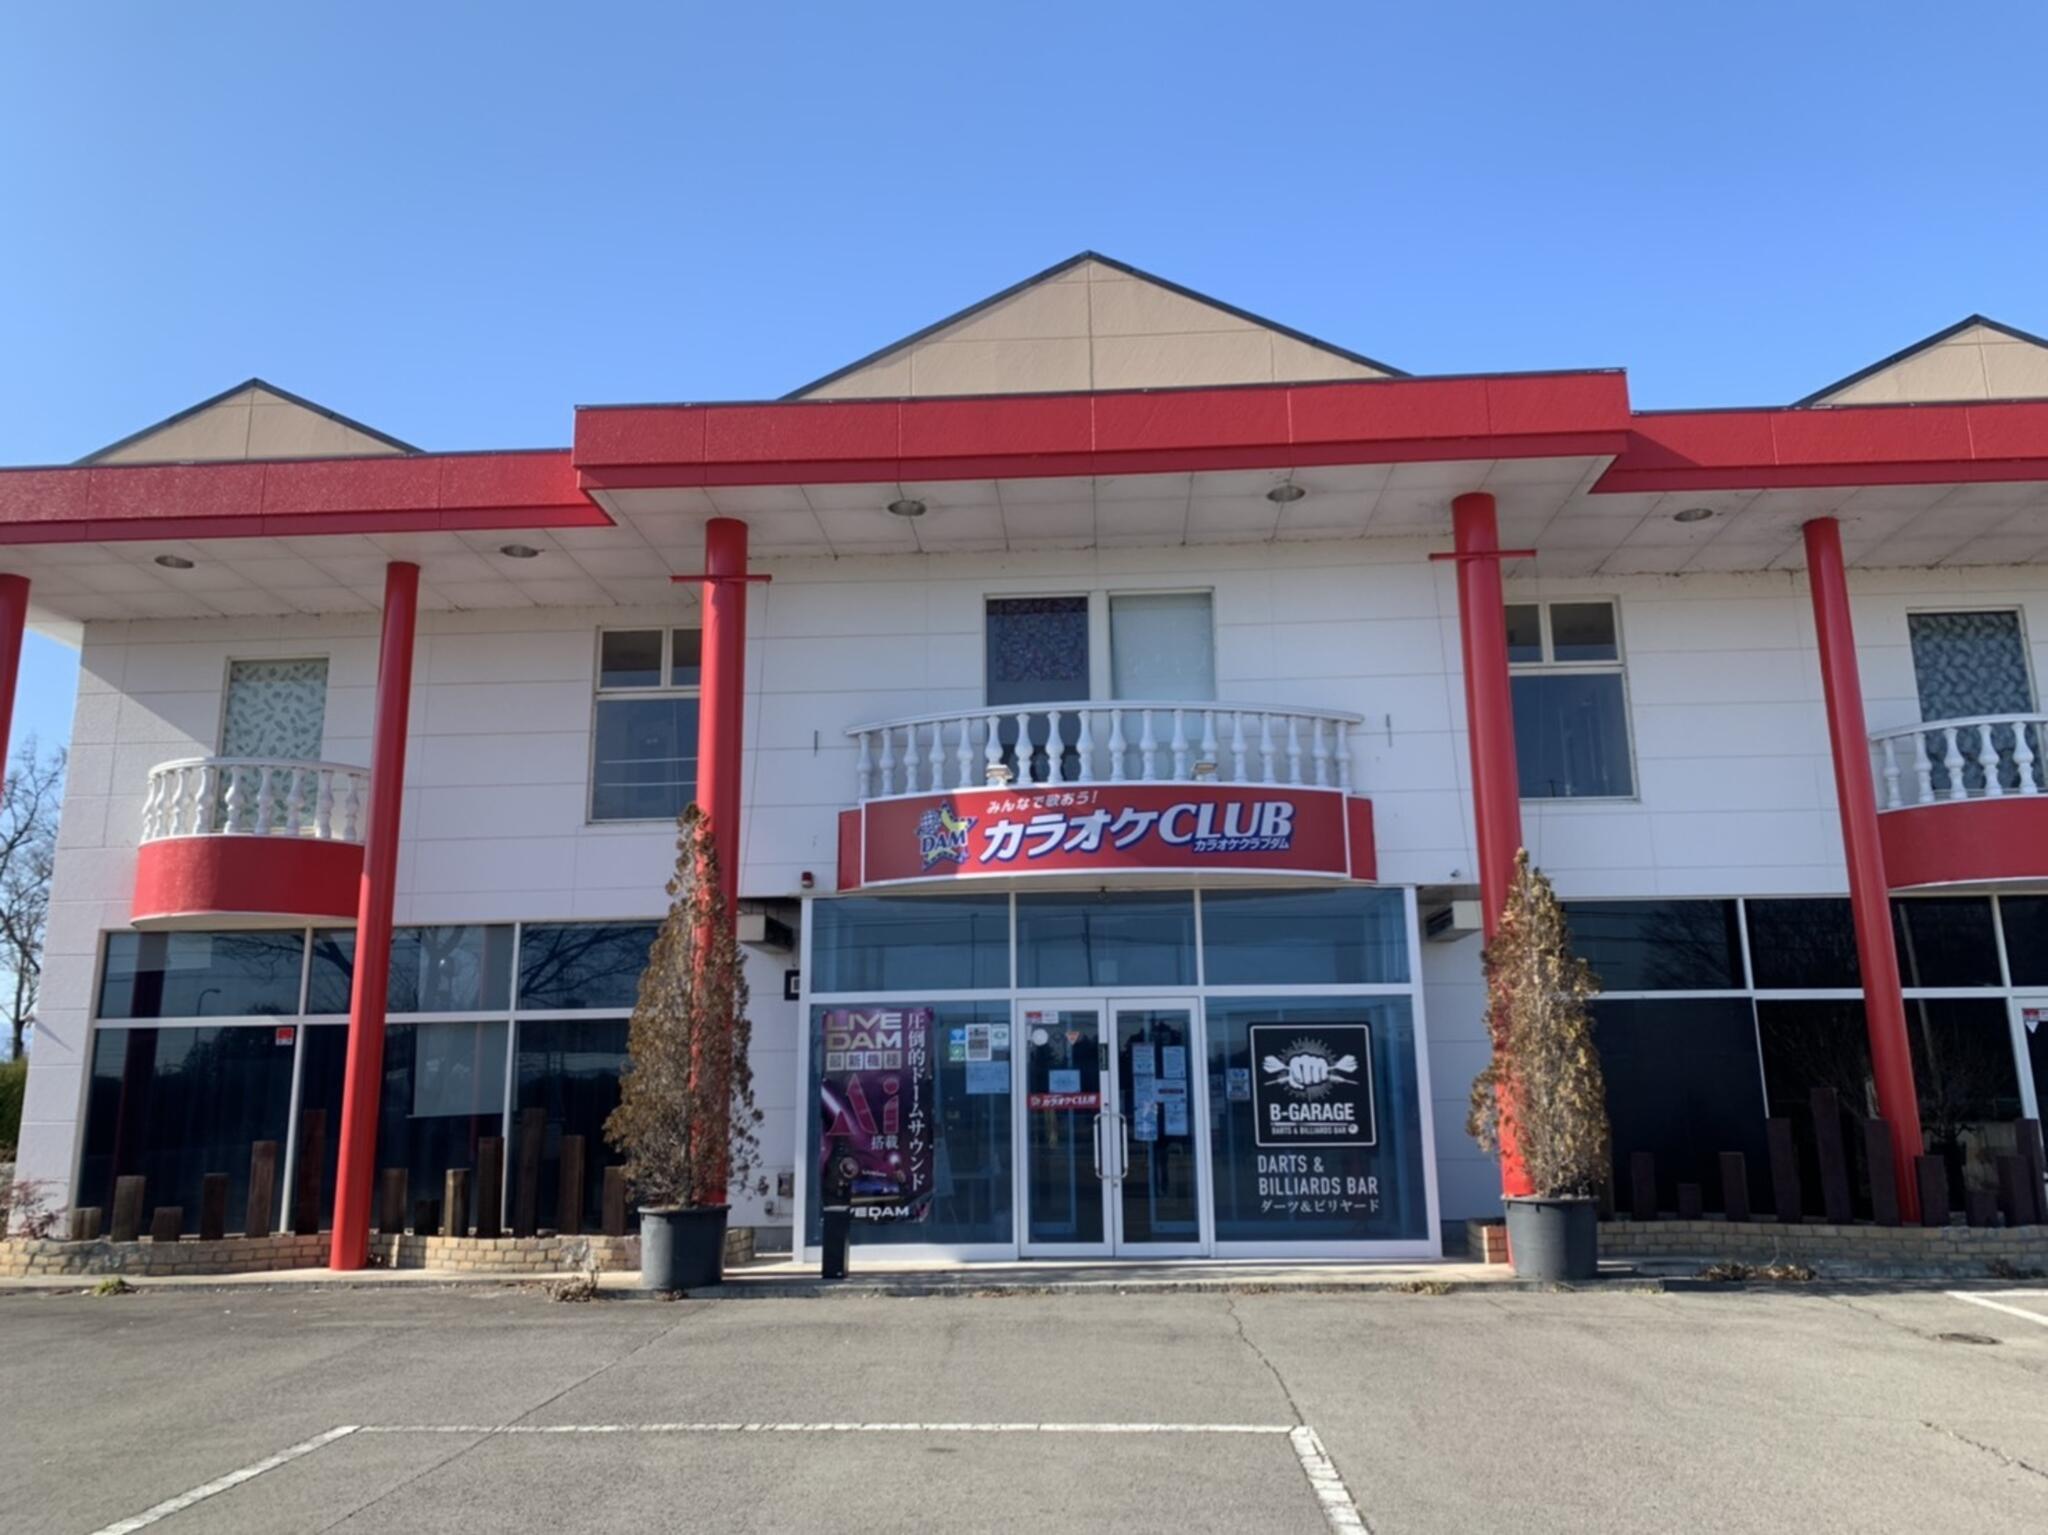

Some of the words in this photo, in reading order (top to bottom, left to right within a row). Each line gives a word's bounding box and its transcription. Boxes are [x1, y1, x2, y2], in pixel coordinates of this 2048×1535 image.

[922, 829, 967, 853] DAM
[979, 801, 1294, 862] カラオケCLUB
[1194, 837, 1290, 852] カラオケクラブダム
[827, 1012, 903, 1031] LIVE
[827, 1031, 902, 1050] DAM
[907, 1012, 926, 1192] 圧倒的ドームサウンド
[1269, 1103, 1355, 1121] B-GARAGE
[1257, 1155, 1308, 1174] DARTS
[1313, 1156, 1325, 1174] &
[1258, 1176, 1341, 1196] BILLIARDS
[1346, 1176, 1379, 1195] BAR
[849, 1206, 910, 1219] EDAM
